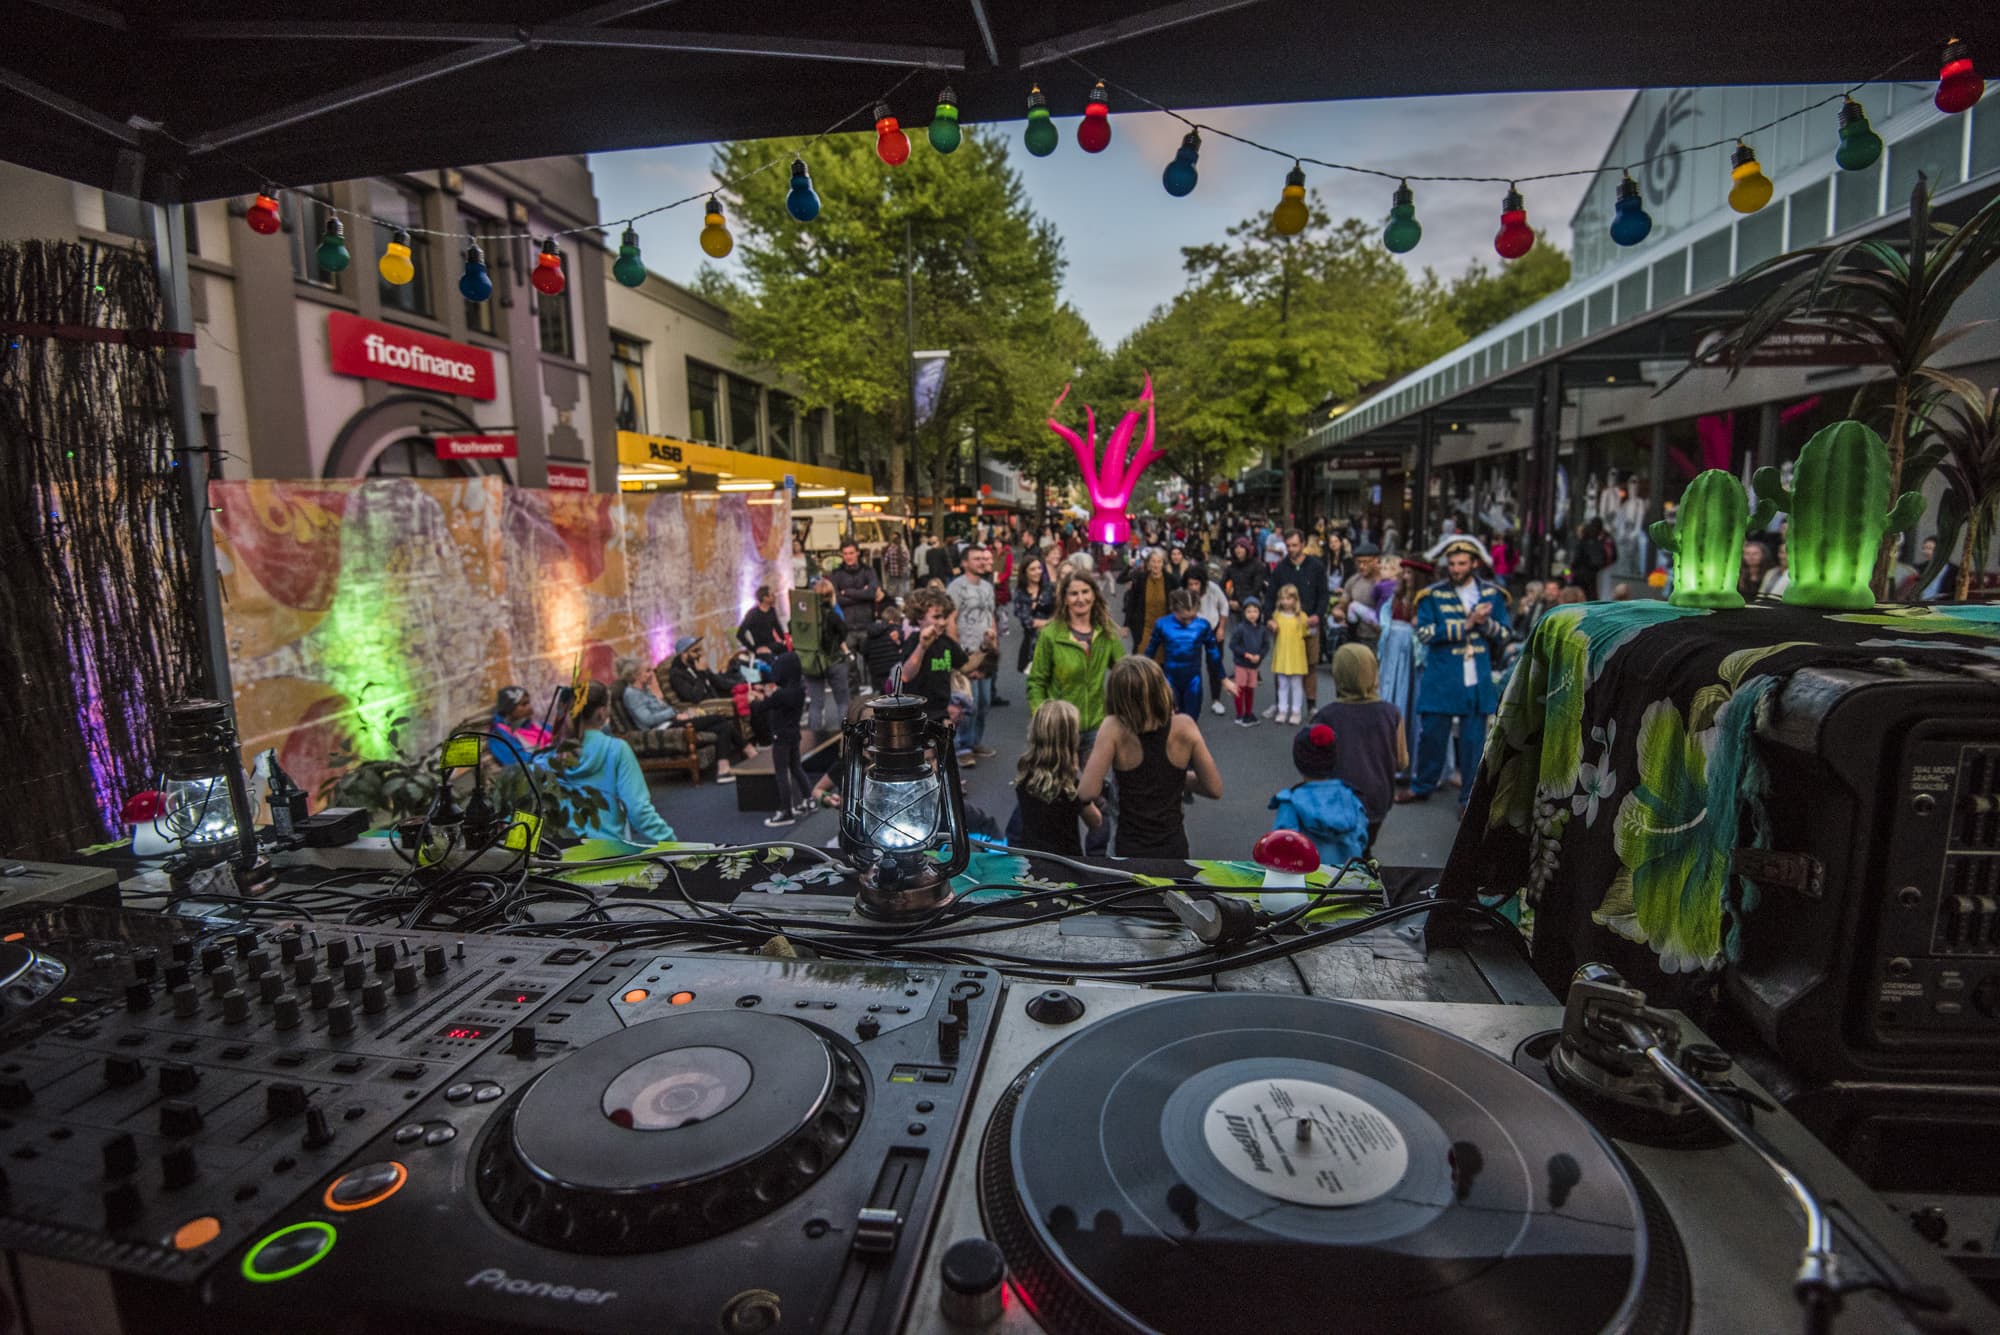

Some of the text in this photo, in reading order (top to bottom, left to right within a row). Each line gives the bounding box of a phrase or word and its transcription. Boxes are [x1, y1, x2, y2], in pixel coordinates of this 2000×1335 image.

[364, 333, 476, 383] ficofinance
[649, 443, 683, 462] ASB
[464, 1267, 619, 1305] Pioneer
